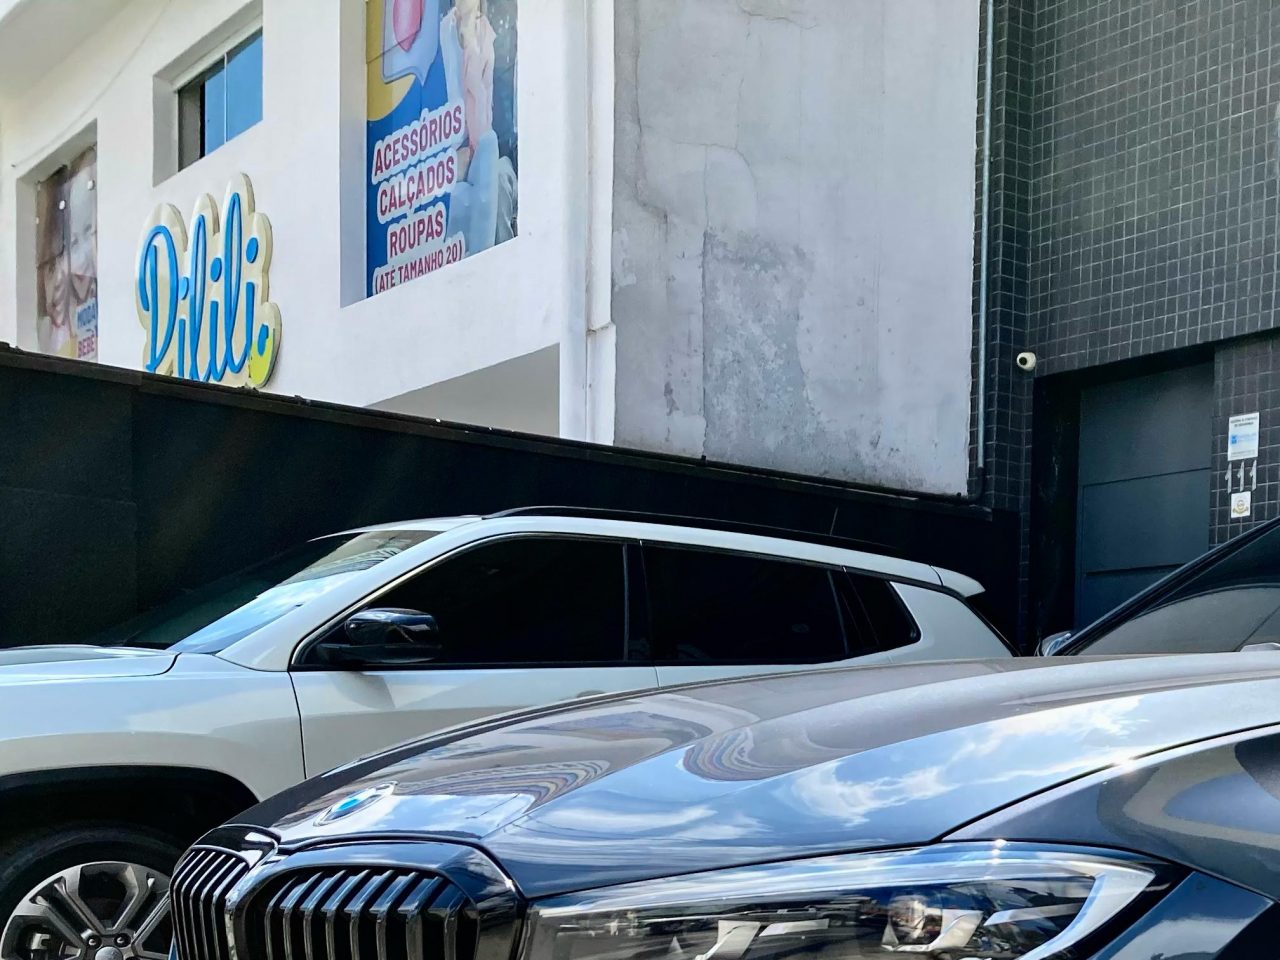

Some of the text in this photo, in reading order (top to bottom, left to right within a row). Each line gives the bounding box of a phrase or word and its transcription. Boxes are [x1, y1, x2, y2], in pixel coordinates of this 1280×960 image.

[374, 105, 462, 176] ACESSÓRIOS
[380, 155, 455, 216] CALÇADOS
[389, 209, 444, 258] ROUPAS
[375, 239, 462, 295] (ATÉ TAMANHO 20)
